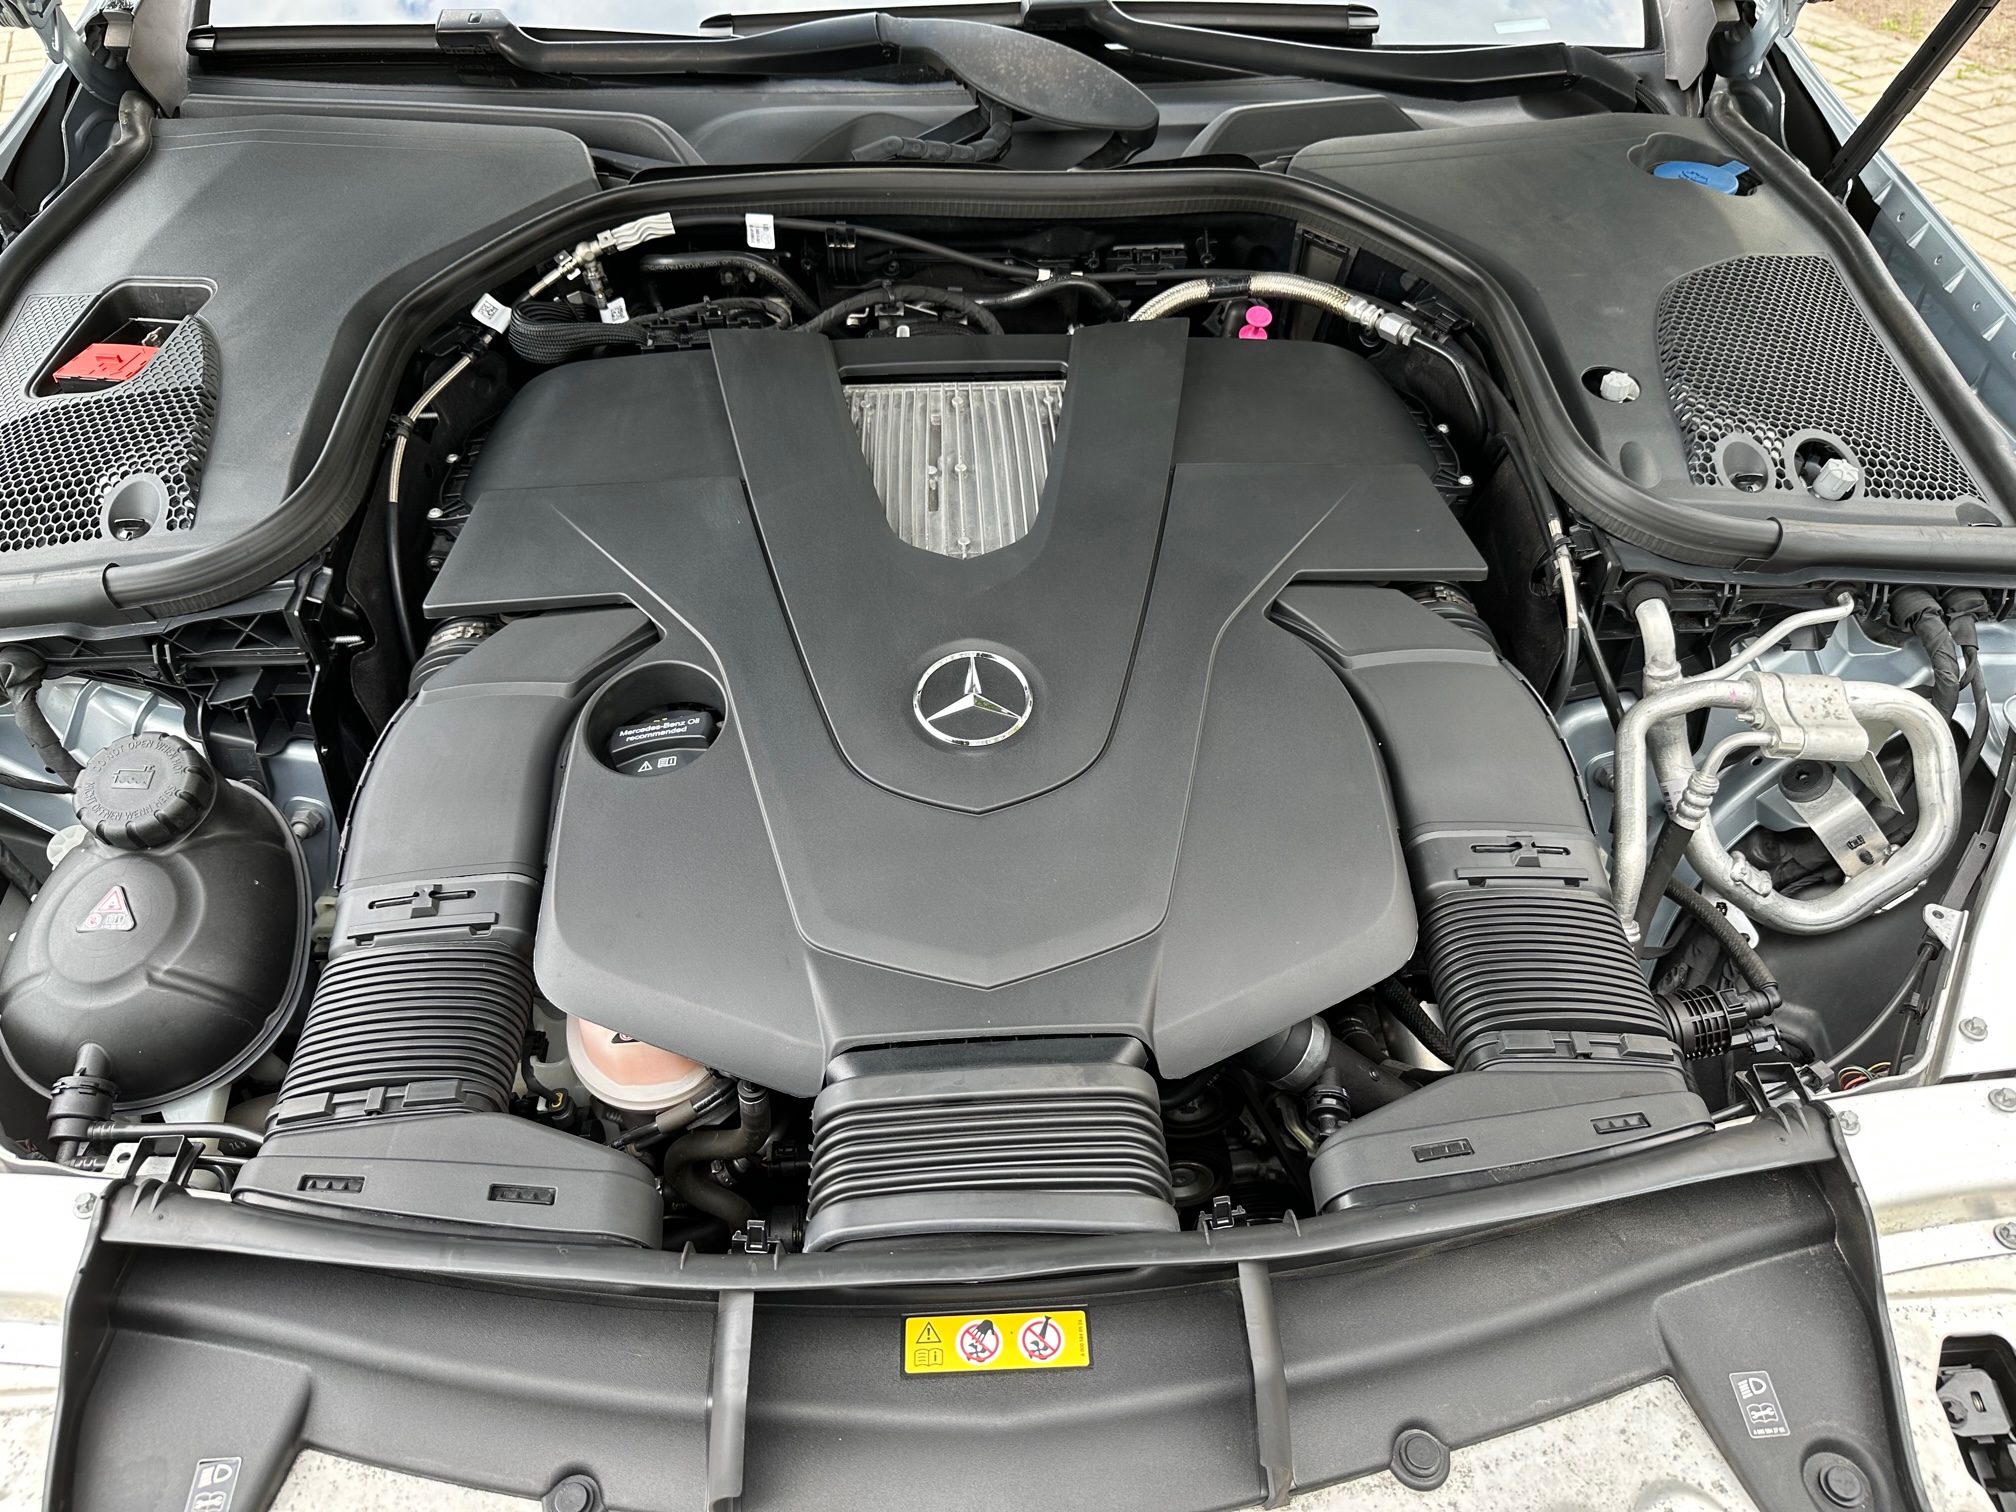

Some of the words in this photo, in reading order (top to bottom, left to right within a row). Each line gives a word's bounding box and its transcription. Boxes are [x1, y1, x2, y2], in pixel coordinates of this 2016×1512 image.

[619, 720, 686, 737] Mercedes-Benz
[687, 717, 701, 726] Oil
[625, 726, 688, 742] recommended
[107, 745, 125, 761] NOT
[127, 739, 155, 750] OPEN
[155, 741, 179, 759] WHEN
[171, 757, 184, 775] HOT
[84, 781, 97, 806] NICHT
[124, 805, 154, 820] WENN
